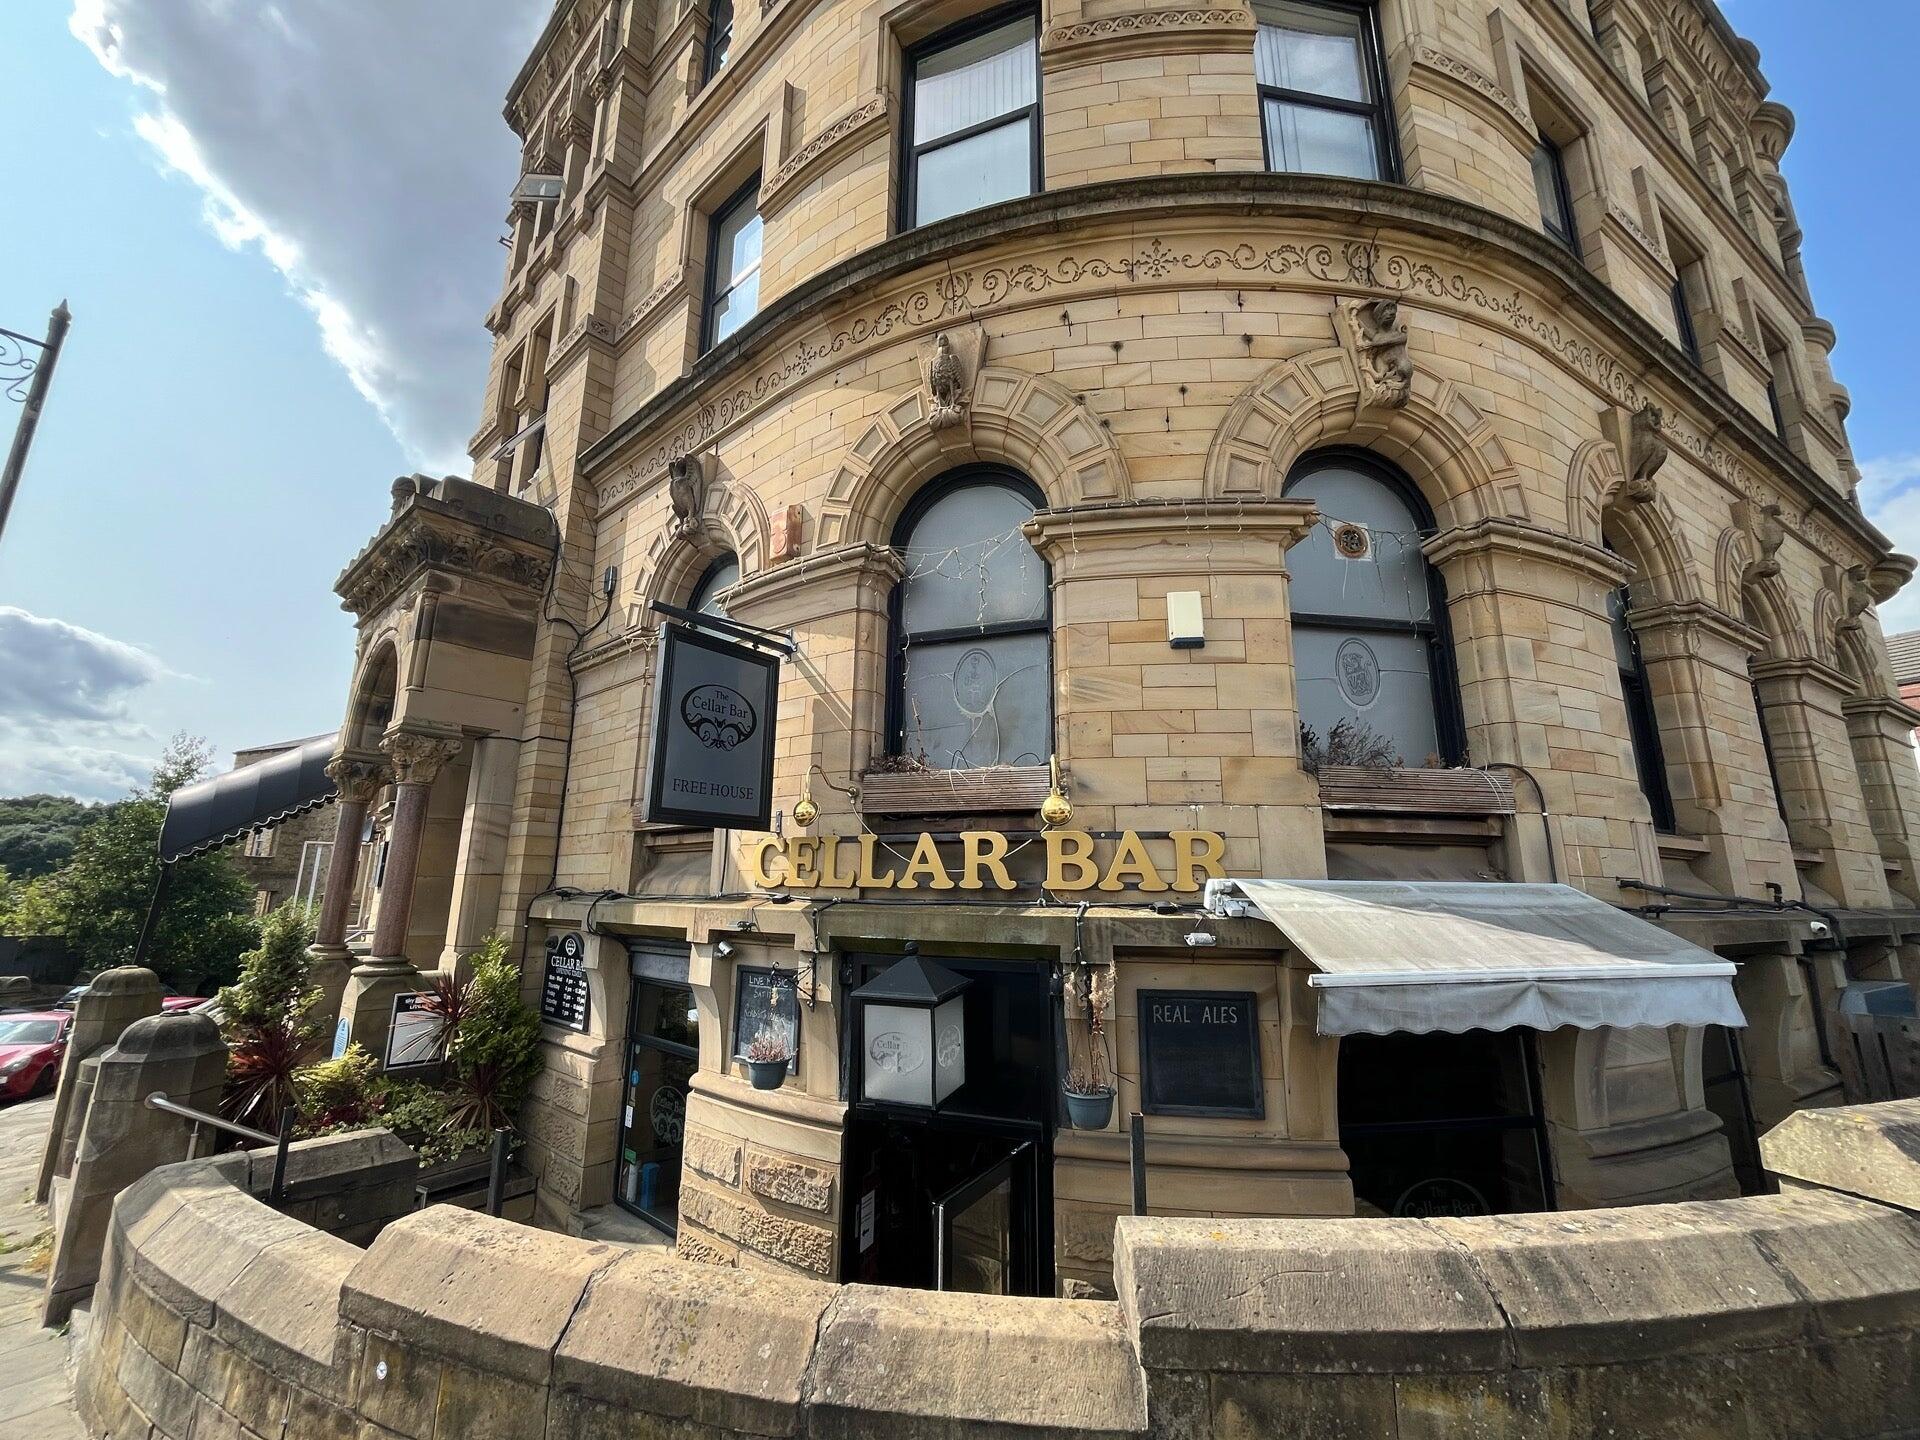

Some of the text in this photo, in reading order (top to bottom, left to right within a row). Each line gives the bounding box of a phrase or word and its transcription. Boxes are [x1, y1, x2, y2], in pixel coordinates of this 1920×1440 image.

[715, 690, 729, 700] The
[692, 695, 748, 718] Cellar Bar
[673, 778, 754, 800] FREE HOUSE
[752, 829, 1227, 892] CELLAR BAR
[551, 956, 574, 969] CELLAR
[749, 975, 788, 987] LIVE MSIC
[1153, 1005, 1238, 1024] REAL ALES
[1428, 1184, 1447, 1199] The
[1405, 1199, 1478, 1217] Cellar Bar
